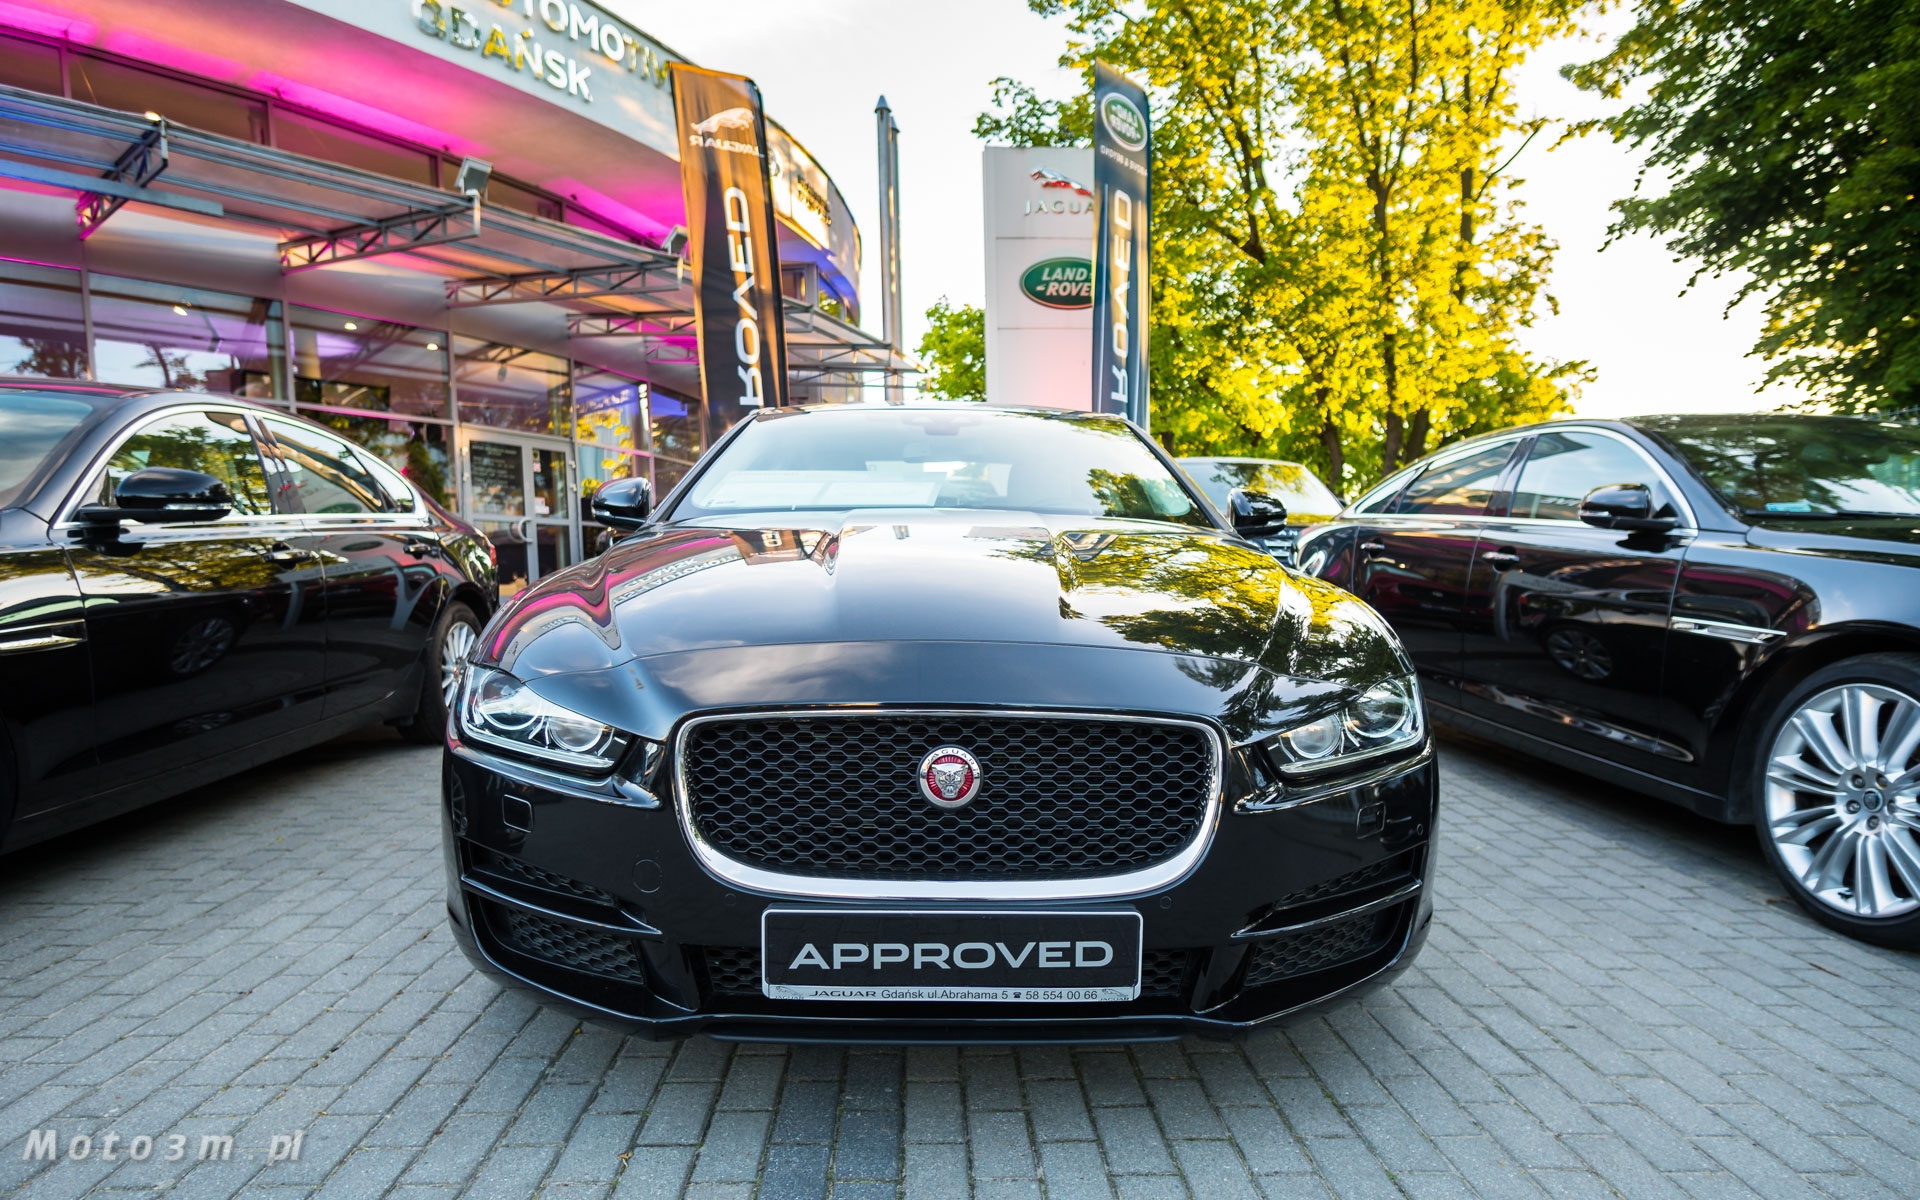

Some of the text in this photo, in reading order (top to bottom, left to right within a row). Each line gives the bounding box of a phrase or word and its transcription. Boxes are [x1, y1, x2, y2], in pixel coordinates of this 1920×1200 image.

[1024, 199, 1093, 217] JAGUA
[1041, 267, 1088, 281] LAND
[1046, 282, 1092, 297] ROVE
[927, 749, 975, 766] JAGUAR
[788, 941, 1114, 970] APPROVED
[809, 989, 1098, 1000] JAGUAR Gdańsk ul.Abrahama 5 58 554 00 66
